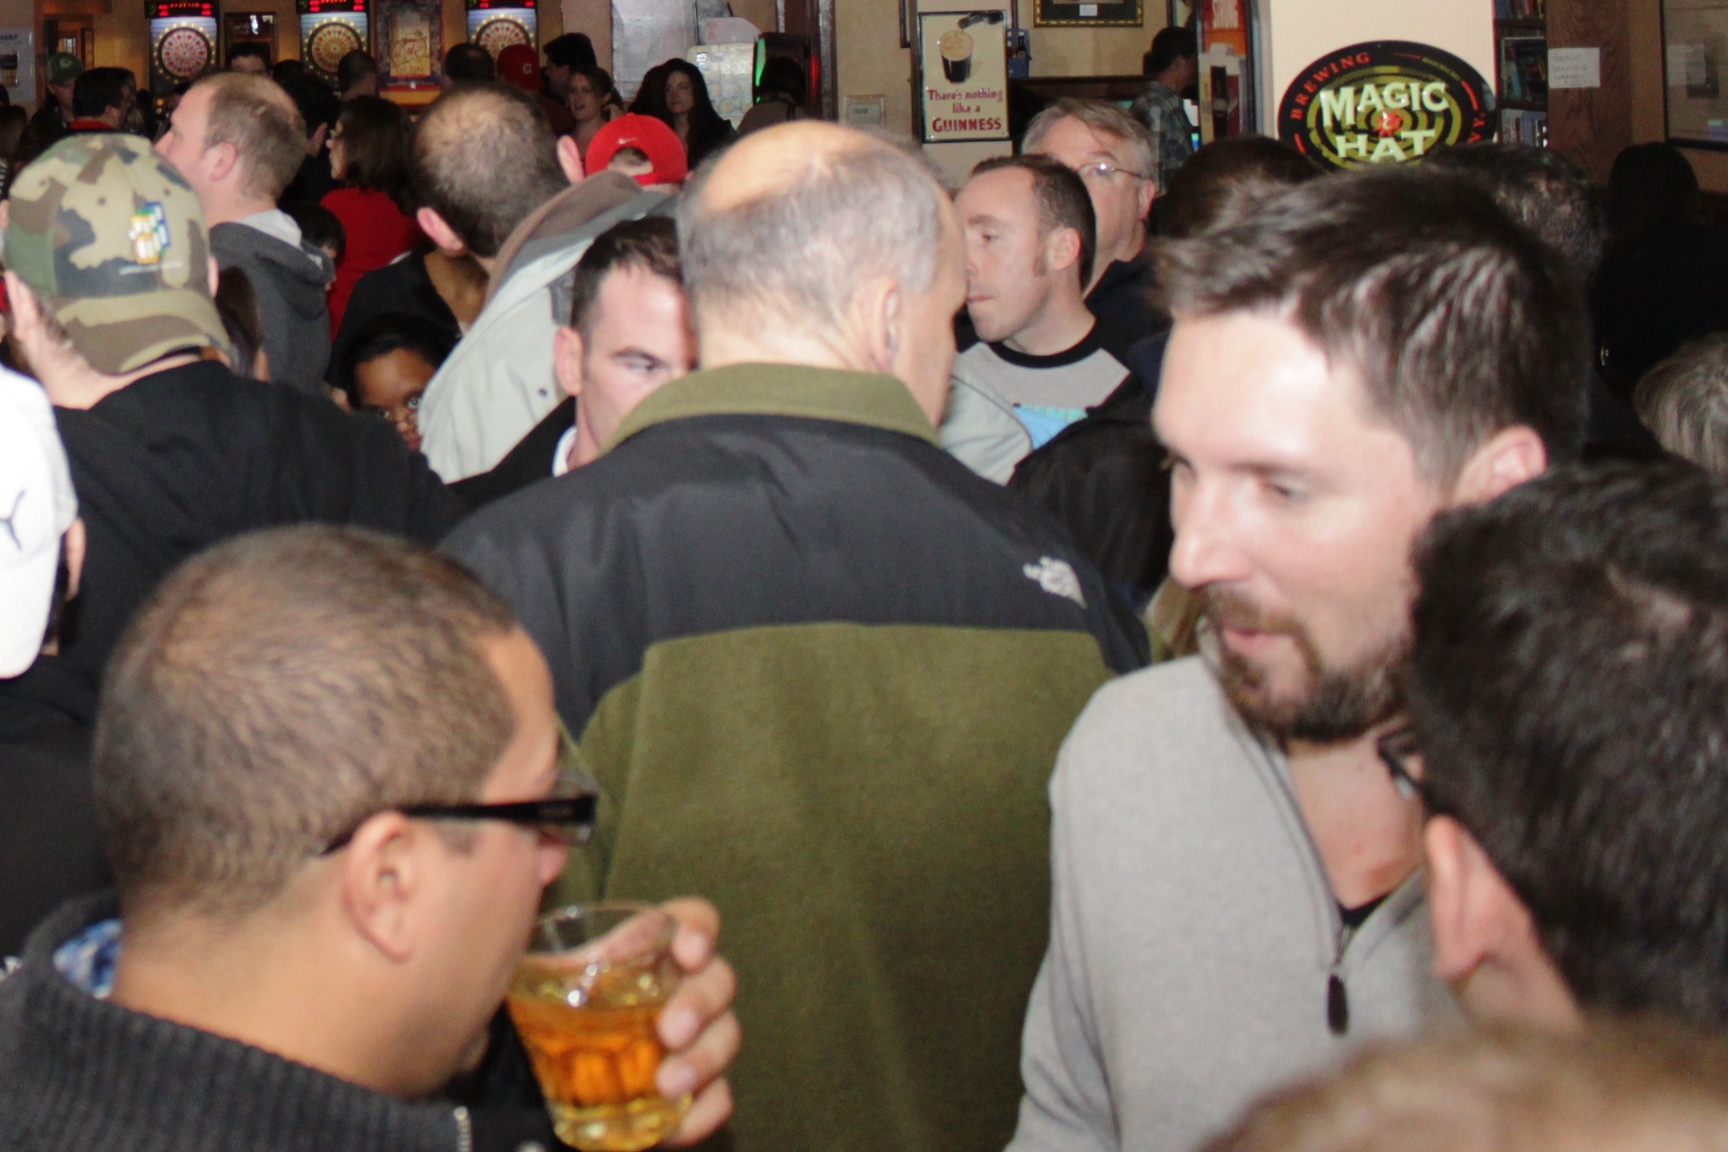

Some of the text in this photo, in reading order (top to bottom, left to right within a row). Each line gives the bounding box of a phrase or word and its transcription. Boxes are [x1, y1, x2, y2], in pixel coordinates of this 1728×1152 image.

[928, 88, 1003, 103] There's nothing
[1290, 51, 1371, 120] BREWING
[952, 103, 981, 113] like a
[1319, 81, 1450, 127] MAGIC
[932, 117, 1002, 132] GUINNESS
[1335, 129, 1436, 163] HAT
